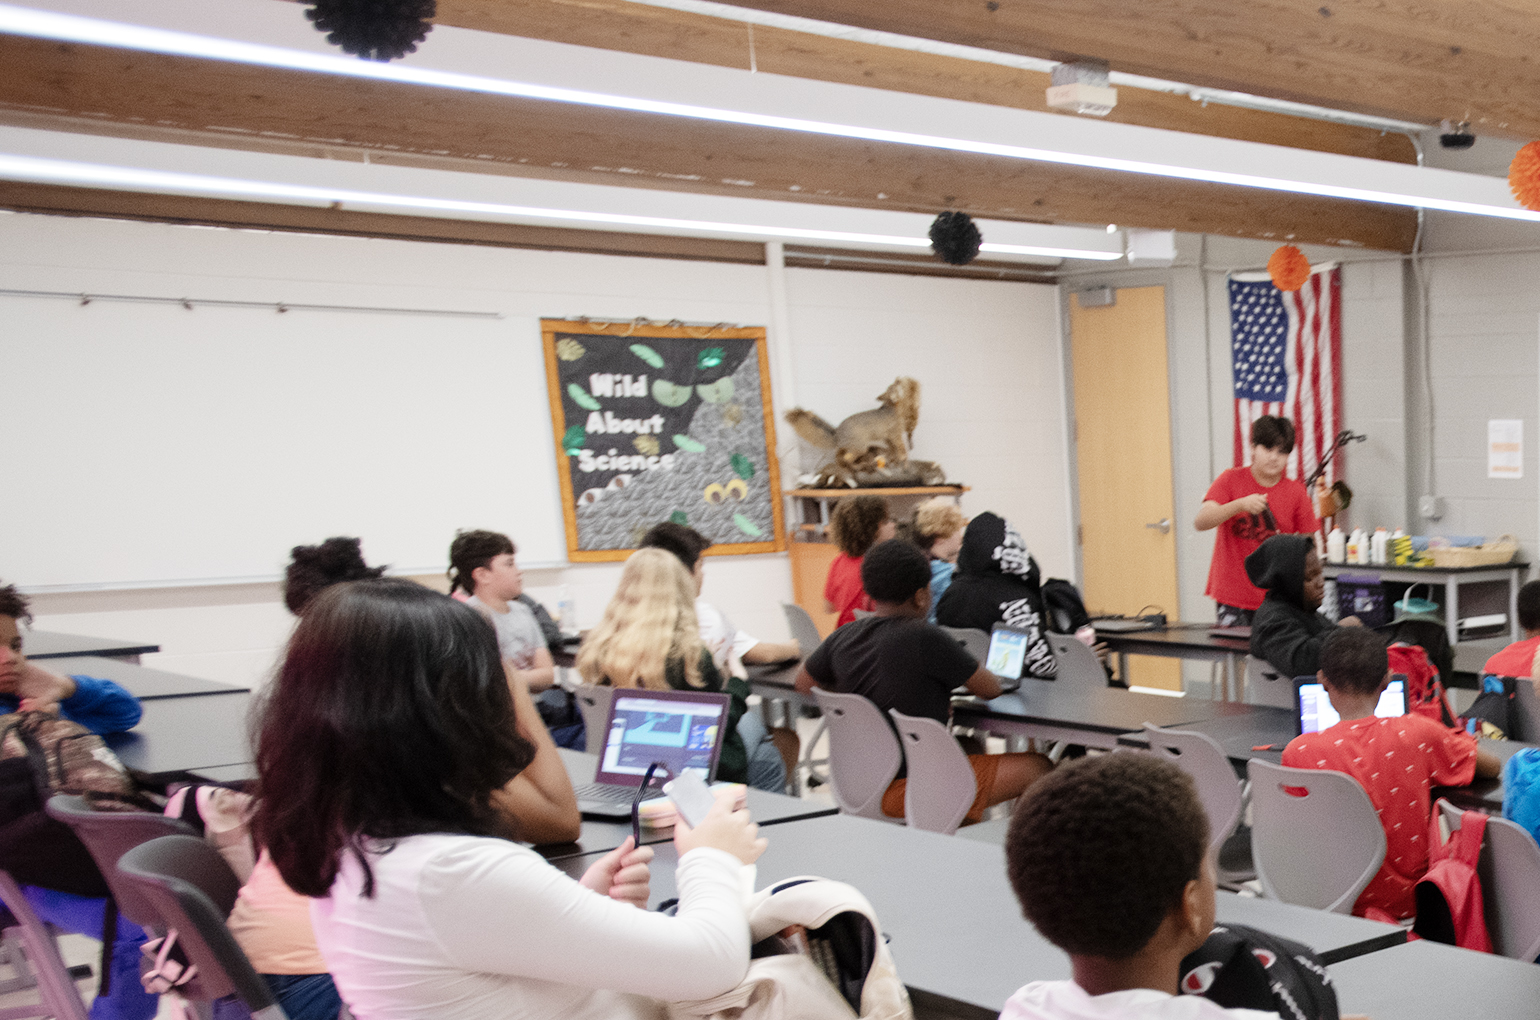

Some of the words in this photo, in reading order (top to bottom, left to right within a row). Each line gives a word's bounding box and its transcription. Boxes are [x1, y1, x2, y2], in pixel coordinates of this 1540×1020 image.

[589, 373, 648, 398] Wild
[584, 411, 665, 434] About
[577, 448, 675, 473] Science
